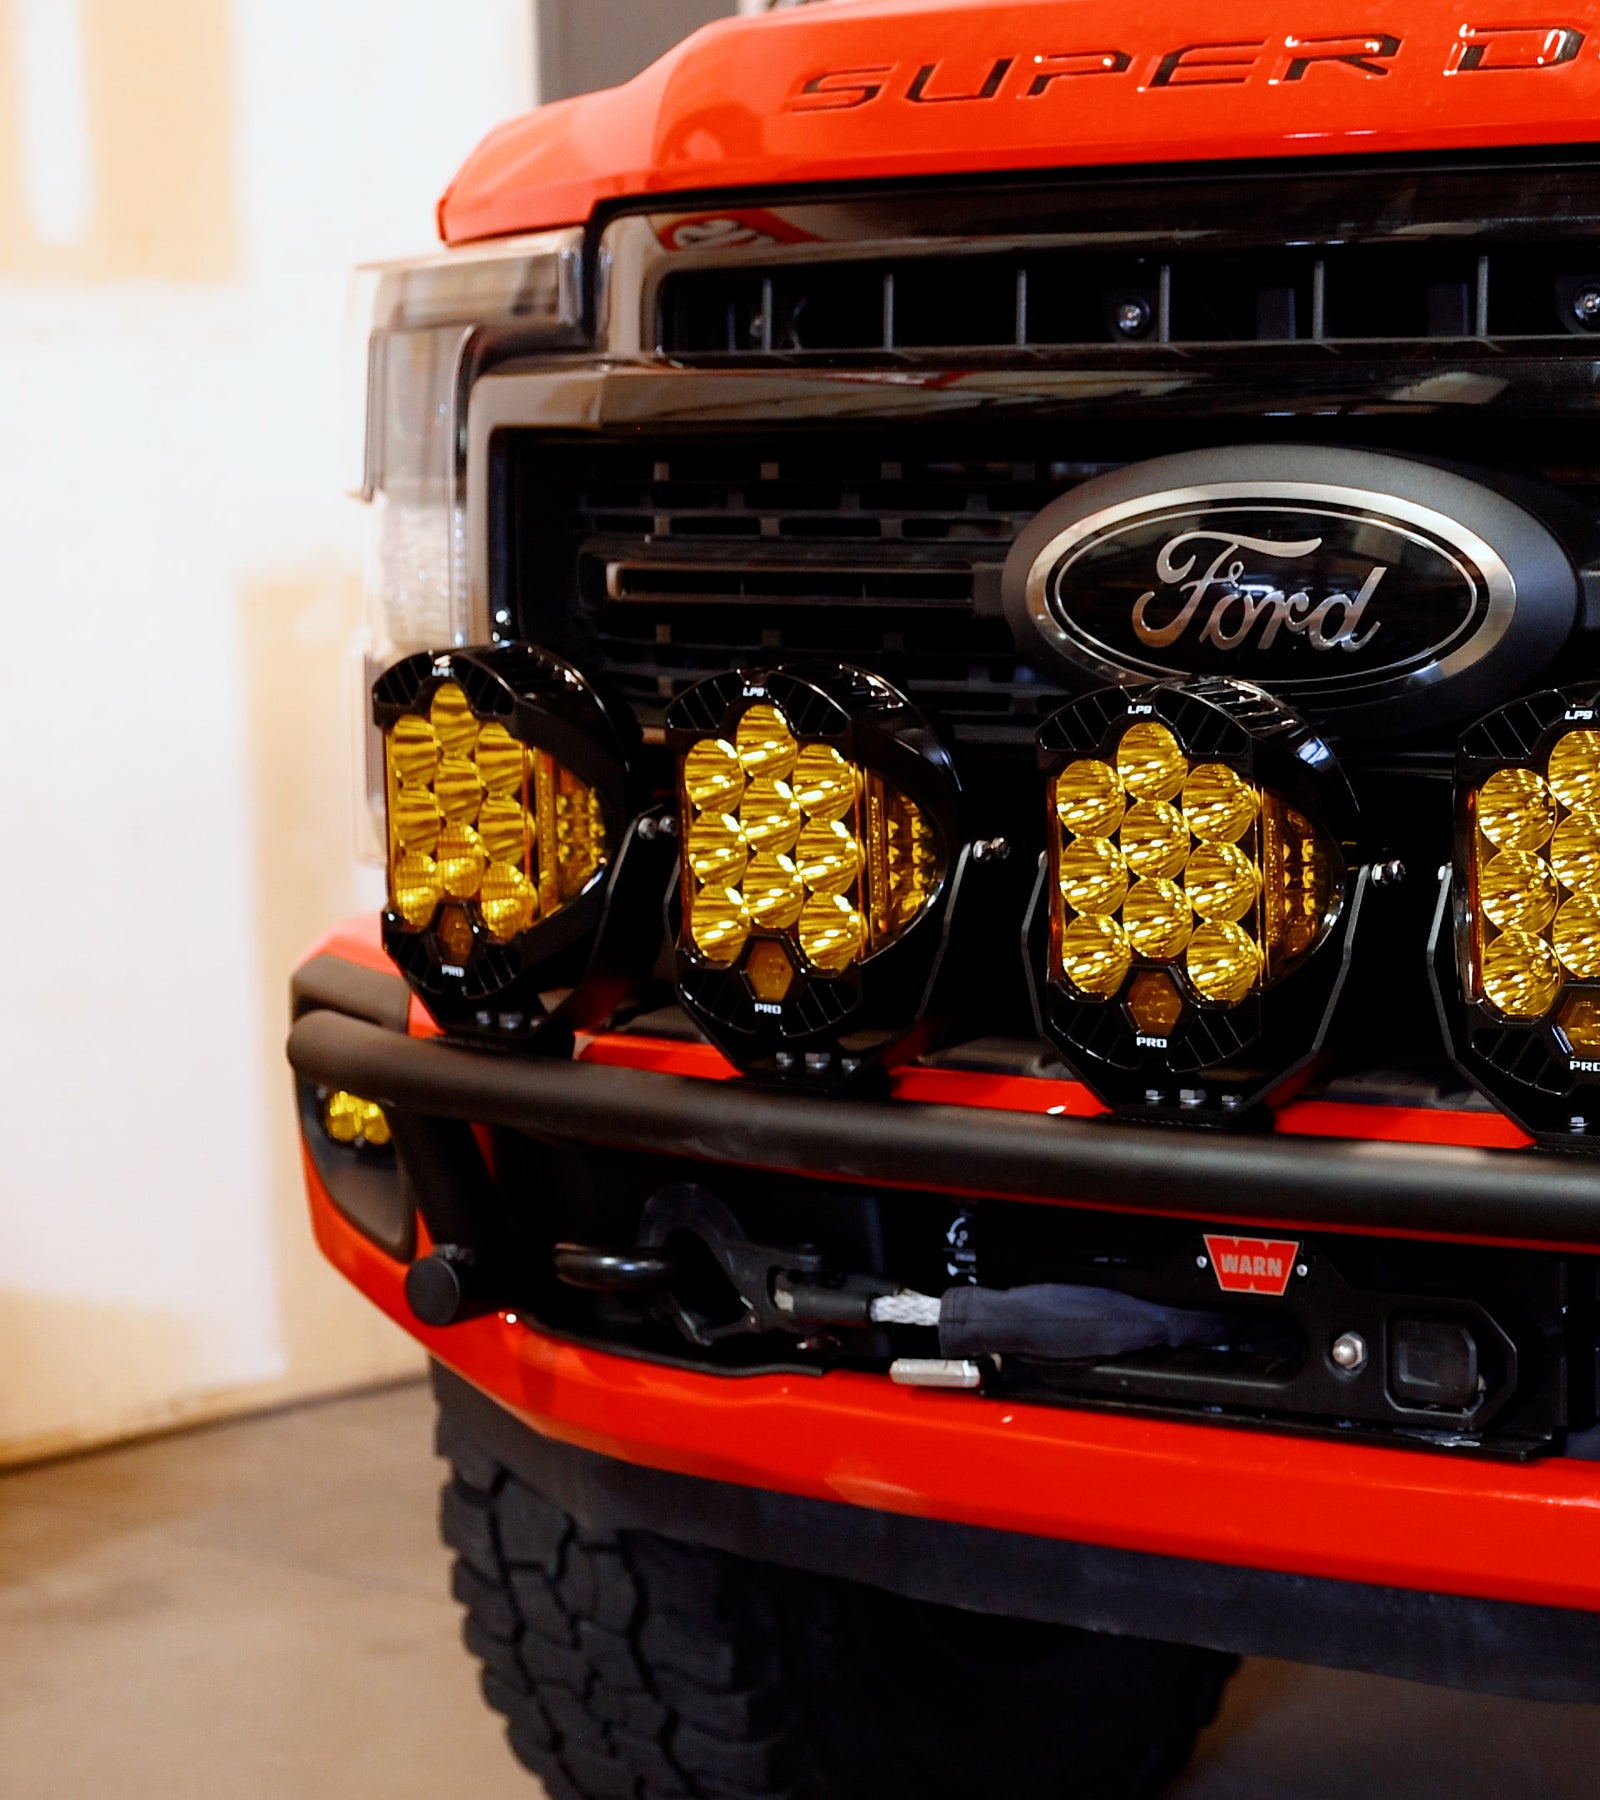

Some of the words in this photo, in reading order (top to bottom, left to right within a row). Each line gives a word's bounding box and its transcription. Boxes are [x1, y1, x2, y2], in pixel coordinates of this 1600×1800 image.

[783, 33, 1403, 111] SUPER
[1131, 530, 1387, 651] Ford
[1127, 705, 1152, 714] LP9
[1564, 710, 1593, 720] LP9
[755, 1002, 782, 1015] PRO
[1136, 1036, 1167, 1048] PRO
[1220, 1253, 1283, 1278] WARN
